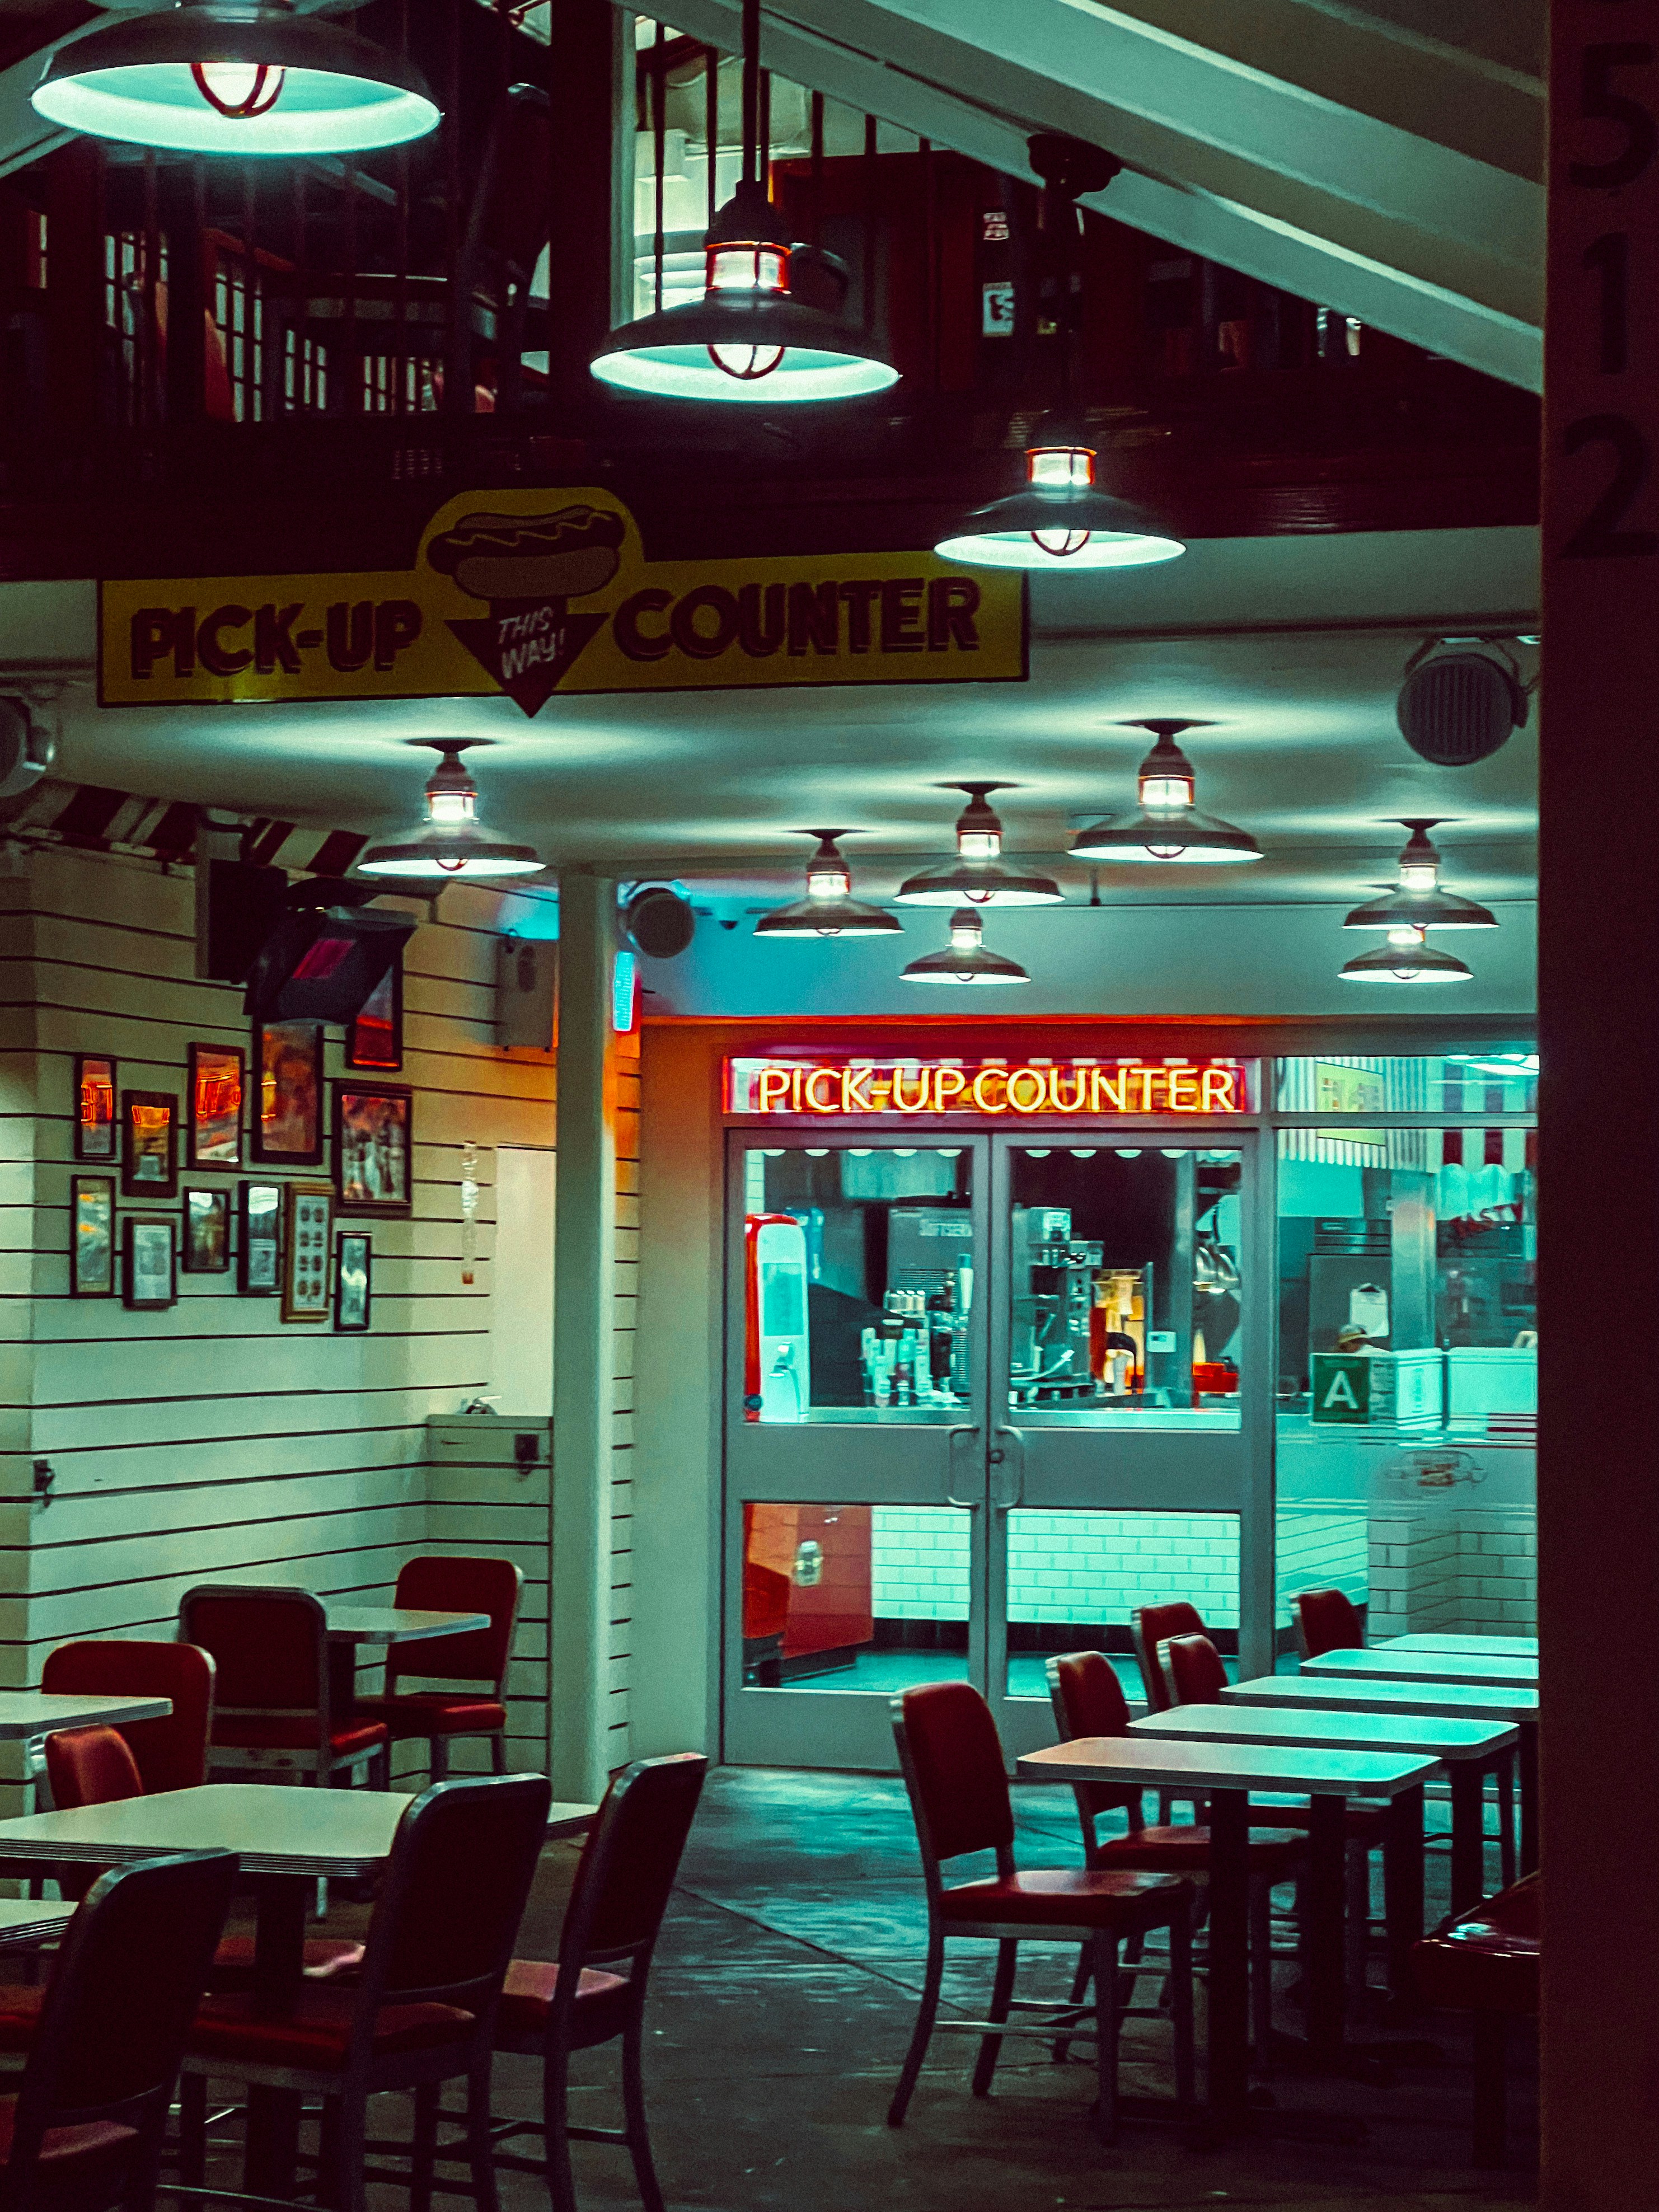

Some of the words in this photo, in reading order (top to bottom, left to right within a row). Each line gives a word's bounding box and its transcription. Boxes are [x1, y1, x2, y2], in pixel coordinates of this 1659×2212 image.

[1560, 0, 1659, 559] 512
[130, 599, 423, 679] PICK-UP
[613, 577, 980, 662] COUNTER
[499, 606, 554, 644] THIS
[758, 1066, 966, 1112] PICK-UP
[972, 1067, 1235, 1113] COUNTER
[1321, 1370, 1359, 1409] A
